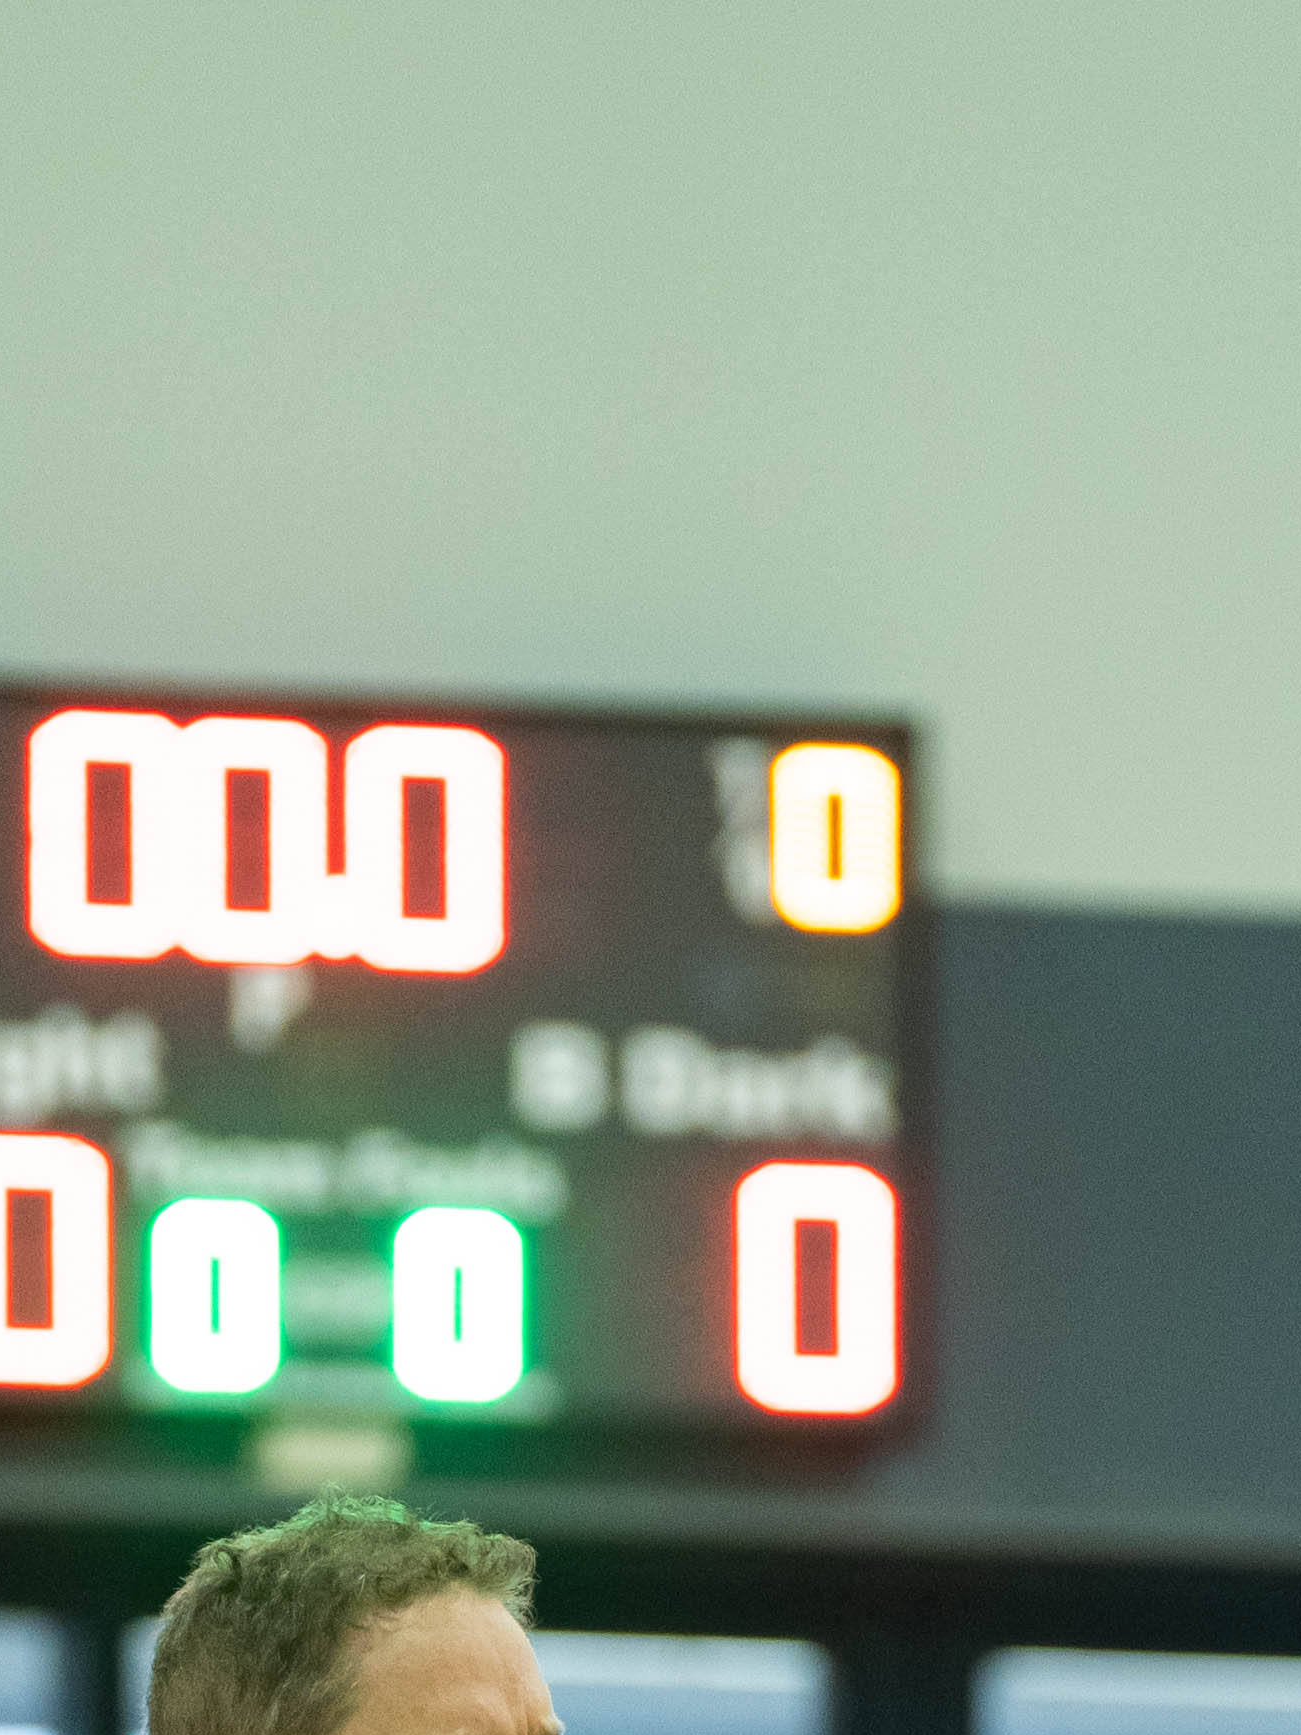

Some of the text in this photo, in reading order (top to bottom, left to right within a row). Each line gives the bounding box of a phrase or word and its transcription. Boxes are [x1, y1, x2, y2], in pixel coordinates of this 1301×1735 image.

[771, 742, 900, 933] 0
[511, 1021, 894, 1140] B Dark
[150, 1197, 281, 1394] 0
[393, 1207, 523, 1402] 0
[734, 1162, 897, 1415] 0
